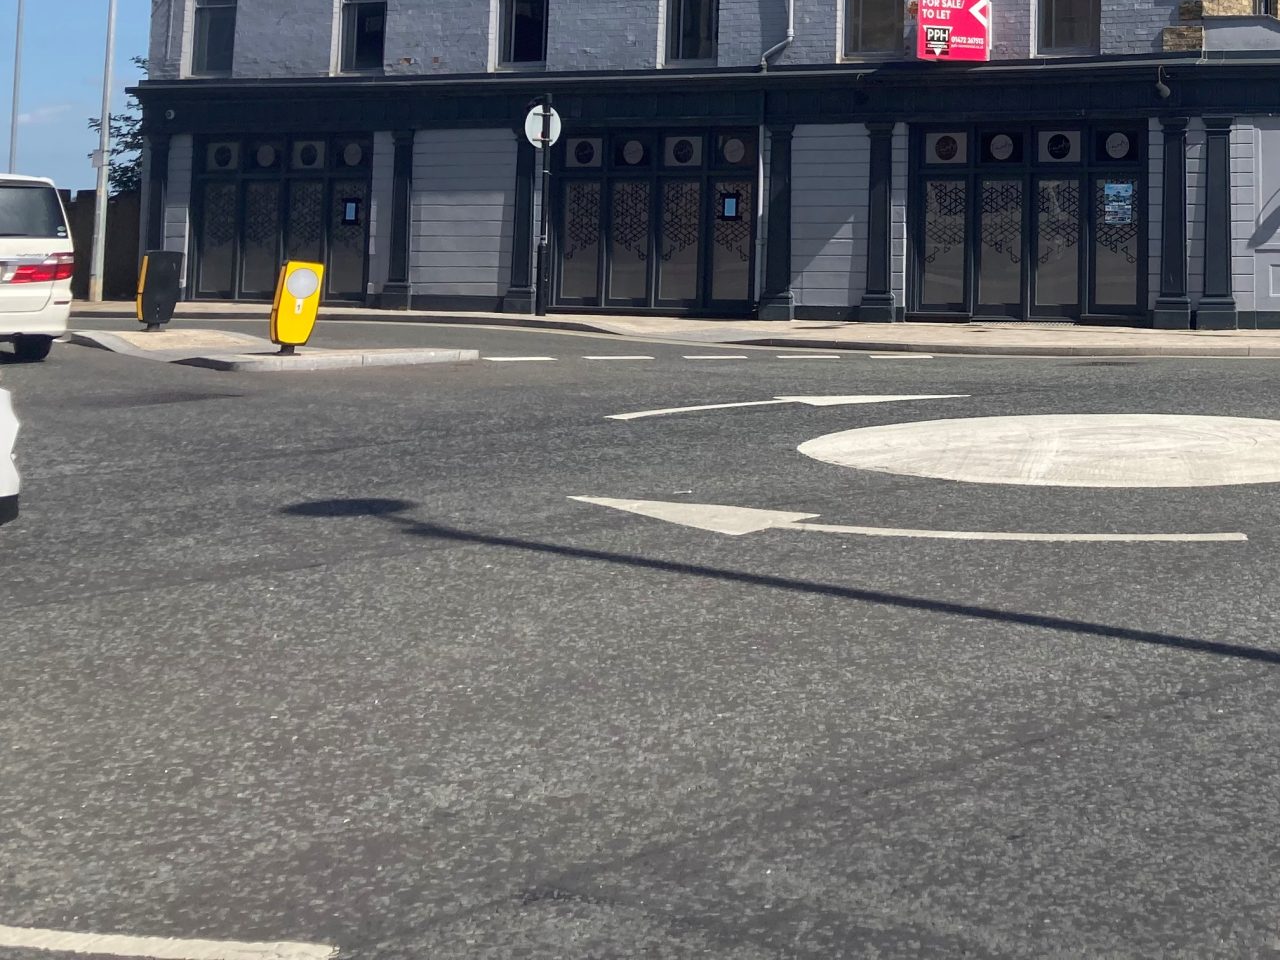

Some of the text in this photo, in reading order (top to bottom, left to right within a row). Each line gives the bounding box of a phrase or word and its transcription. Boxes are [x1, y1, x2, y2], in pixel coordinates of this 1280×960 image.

[941, 0, 965, 9] SALE/
[922, 8, 951, 20] TO LET
[926, 29, 948, 41] PPH
